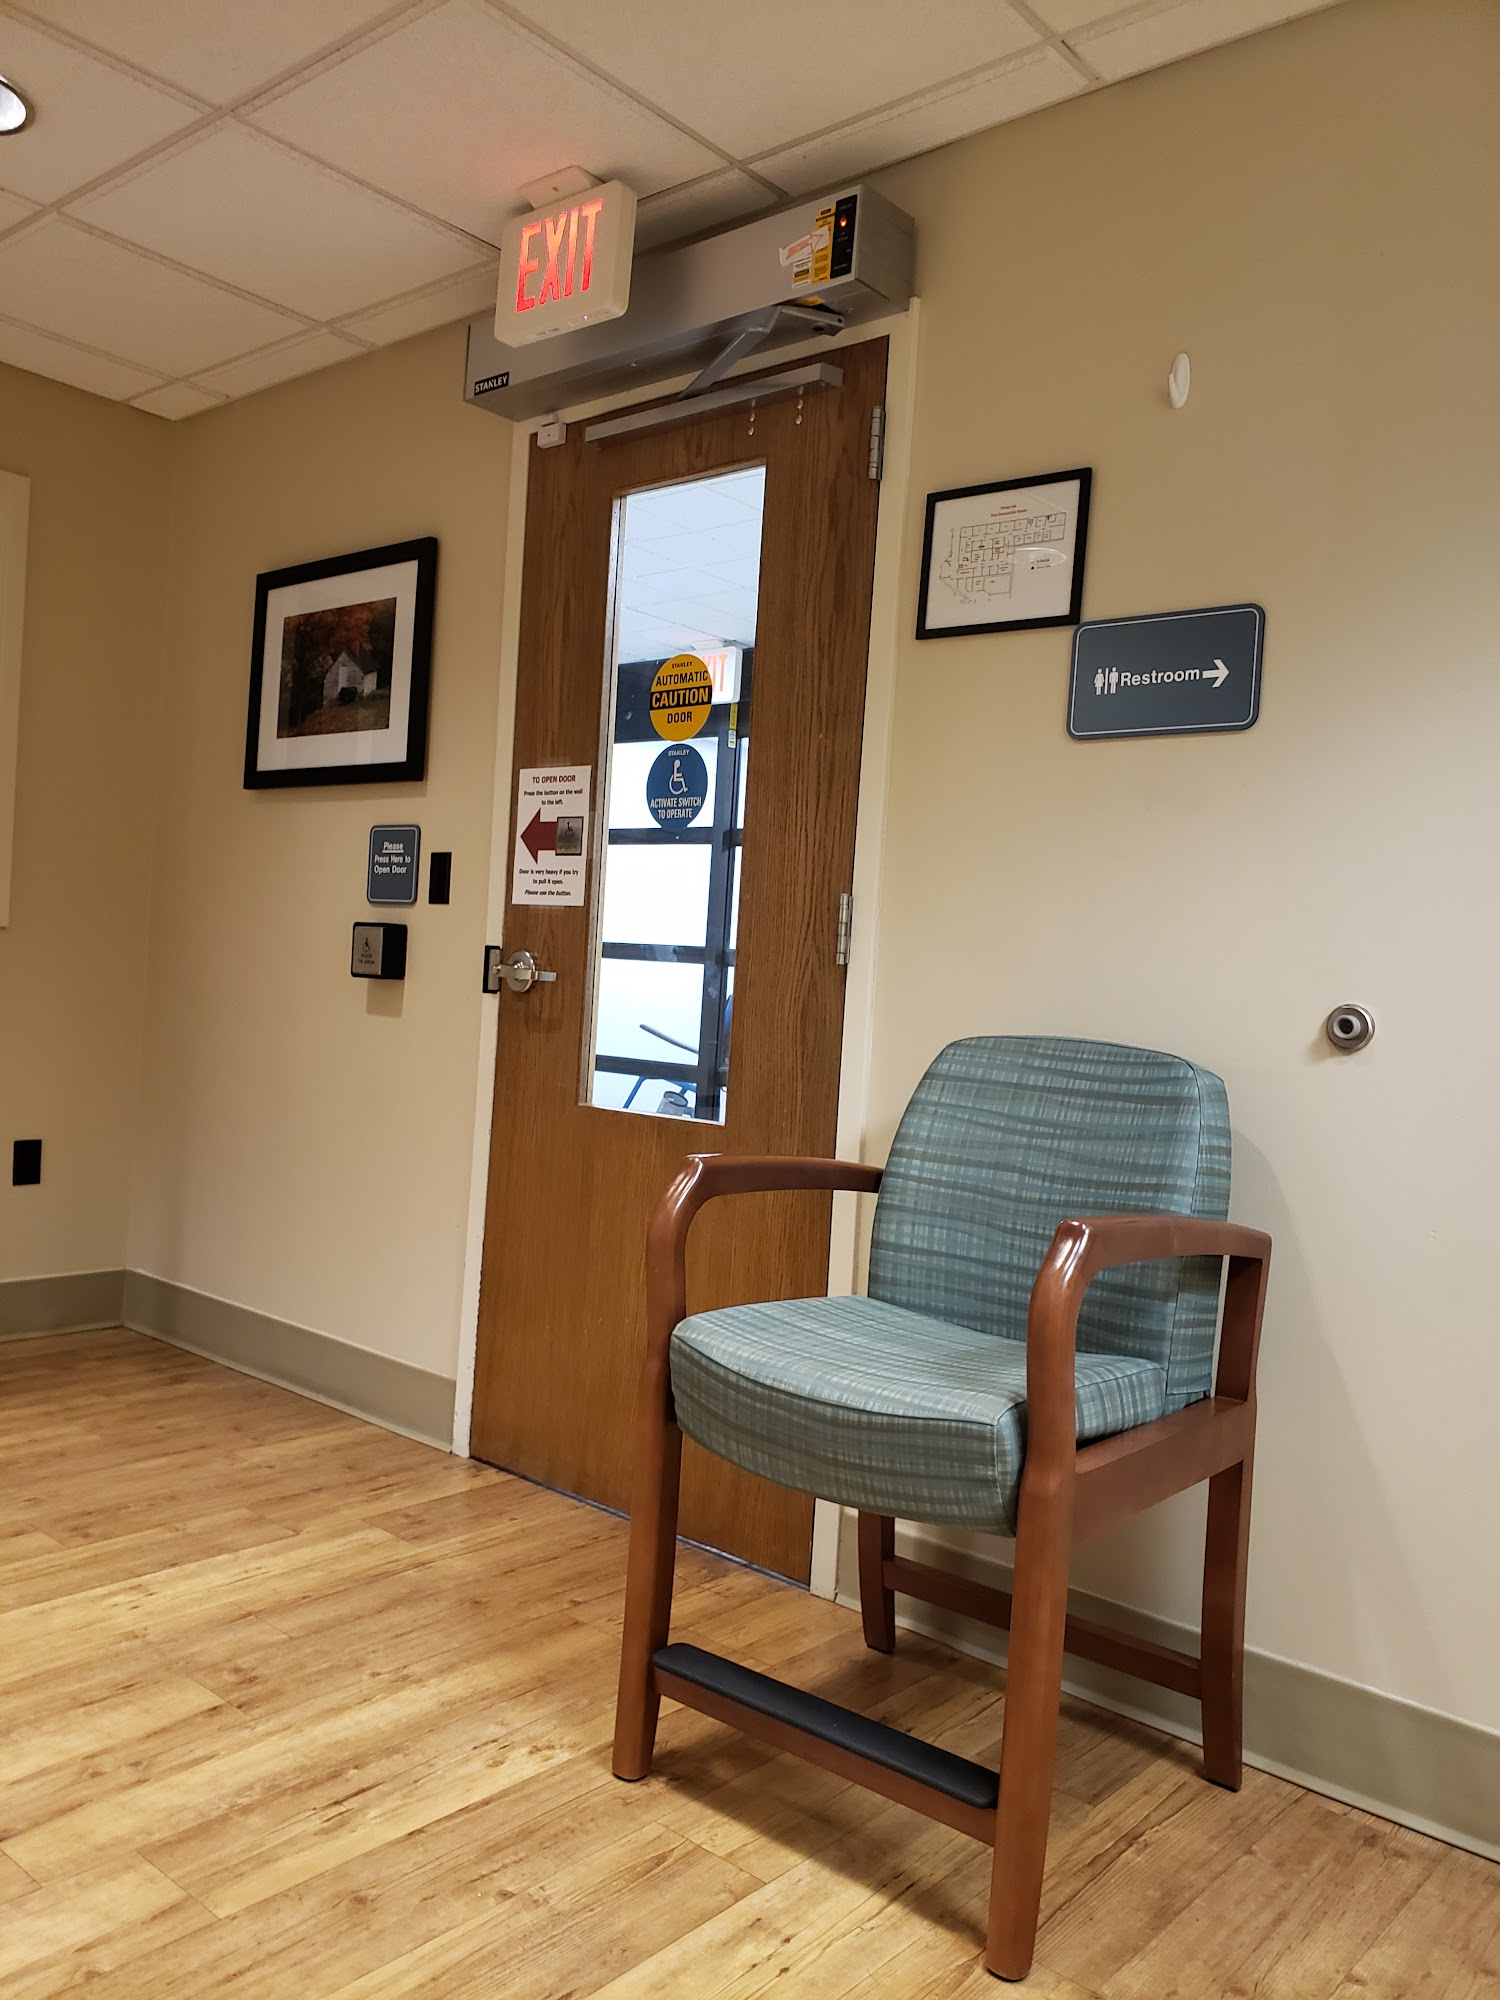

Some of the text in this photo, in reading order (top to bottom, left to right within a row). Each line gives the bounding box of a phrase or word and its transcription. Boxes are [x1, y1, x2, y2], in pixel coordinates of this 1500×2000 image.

[516, 199, 604, 313] EXIT
[475, 375, 508, 394] STANLEY
[672, 661, 693, 669] STANLEY
[656, 670, 708, 687] AUTOMATIC
[1120, 667, 1200, 687] Restroom
[652, 687, 709, 708] CAUTION
[667, 711, 693, 724] DOOR
[668, 749, 690, 757] STANLEY
[532, 776, 540, 784] TO
[558, 774, 576, 782] DOOR
[650, 796, 701, 809] ACTIVATE SWITCH
[658, 808, 693, 819] TO OPERATE
[383, 841, 404, 850] Please
[374, 854, 411, 864] Press Here to
[374, 864, 407, 875] Open Door
